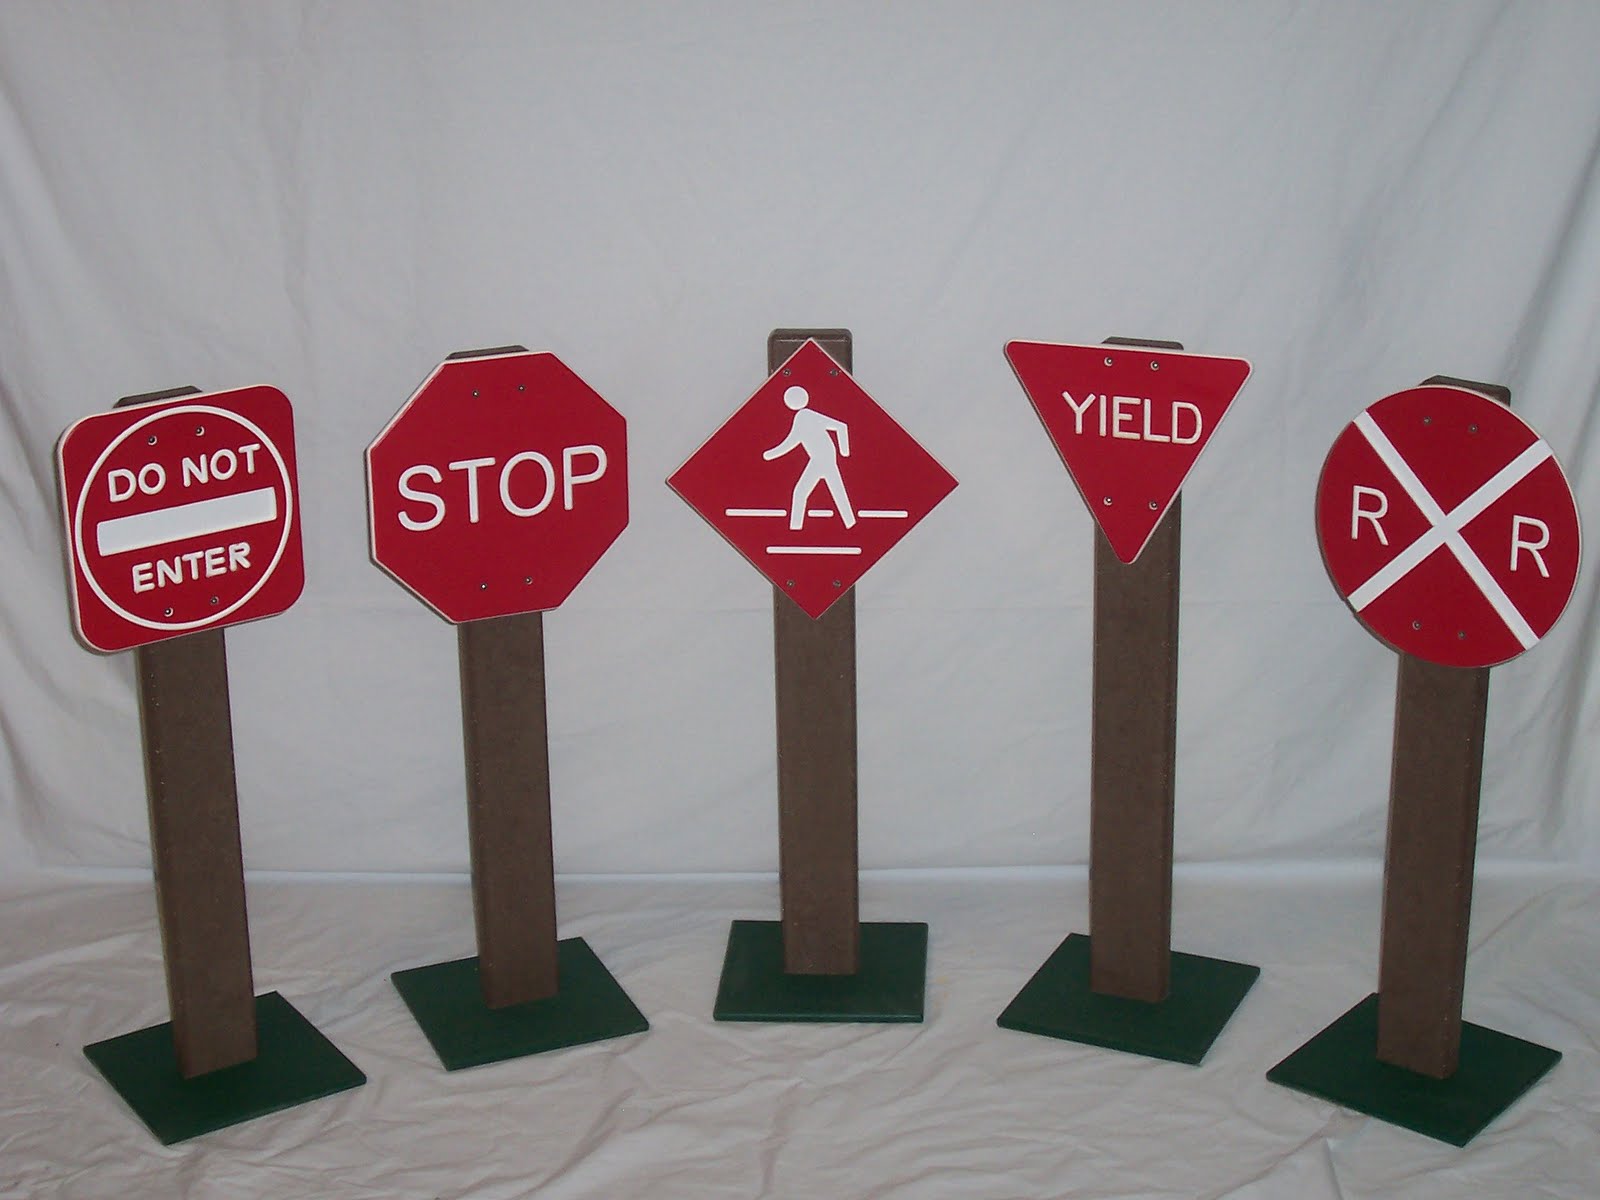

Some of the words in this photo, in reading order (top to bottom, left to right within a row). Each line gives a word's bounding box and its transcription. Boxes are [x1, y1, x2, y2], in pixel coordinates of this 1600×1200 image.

[1062, 391, 1203, 445] YIELD
[107, 462, 166, 503] DO
[181, 443, 261, 488] NOT
[397, 444, 608, 532] STOP
[1351, 485, 1389, 546] R
[132, 541, 252, 594] ENTER
[1510, 514, 1550, 578] R
